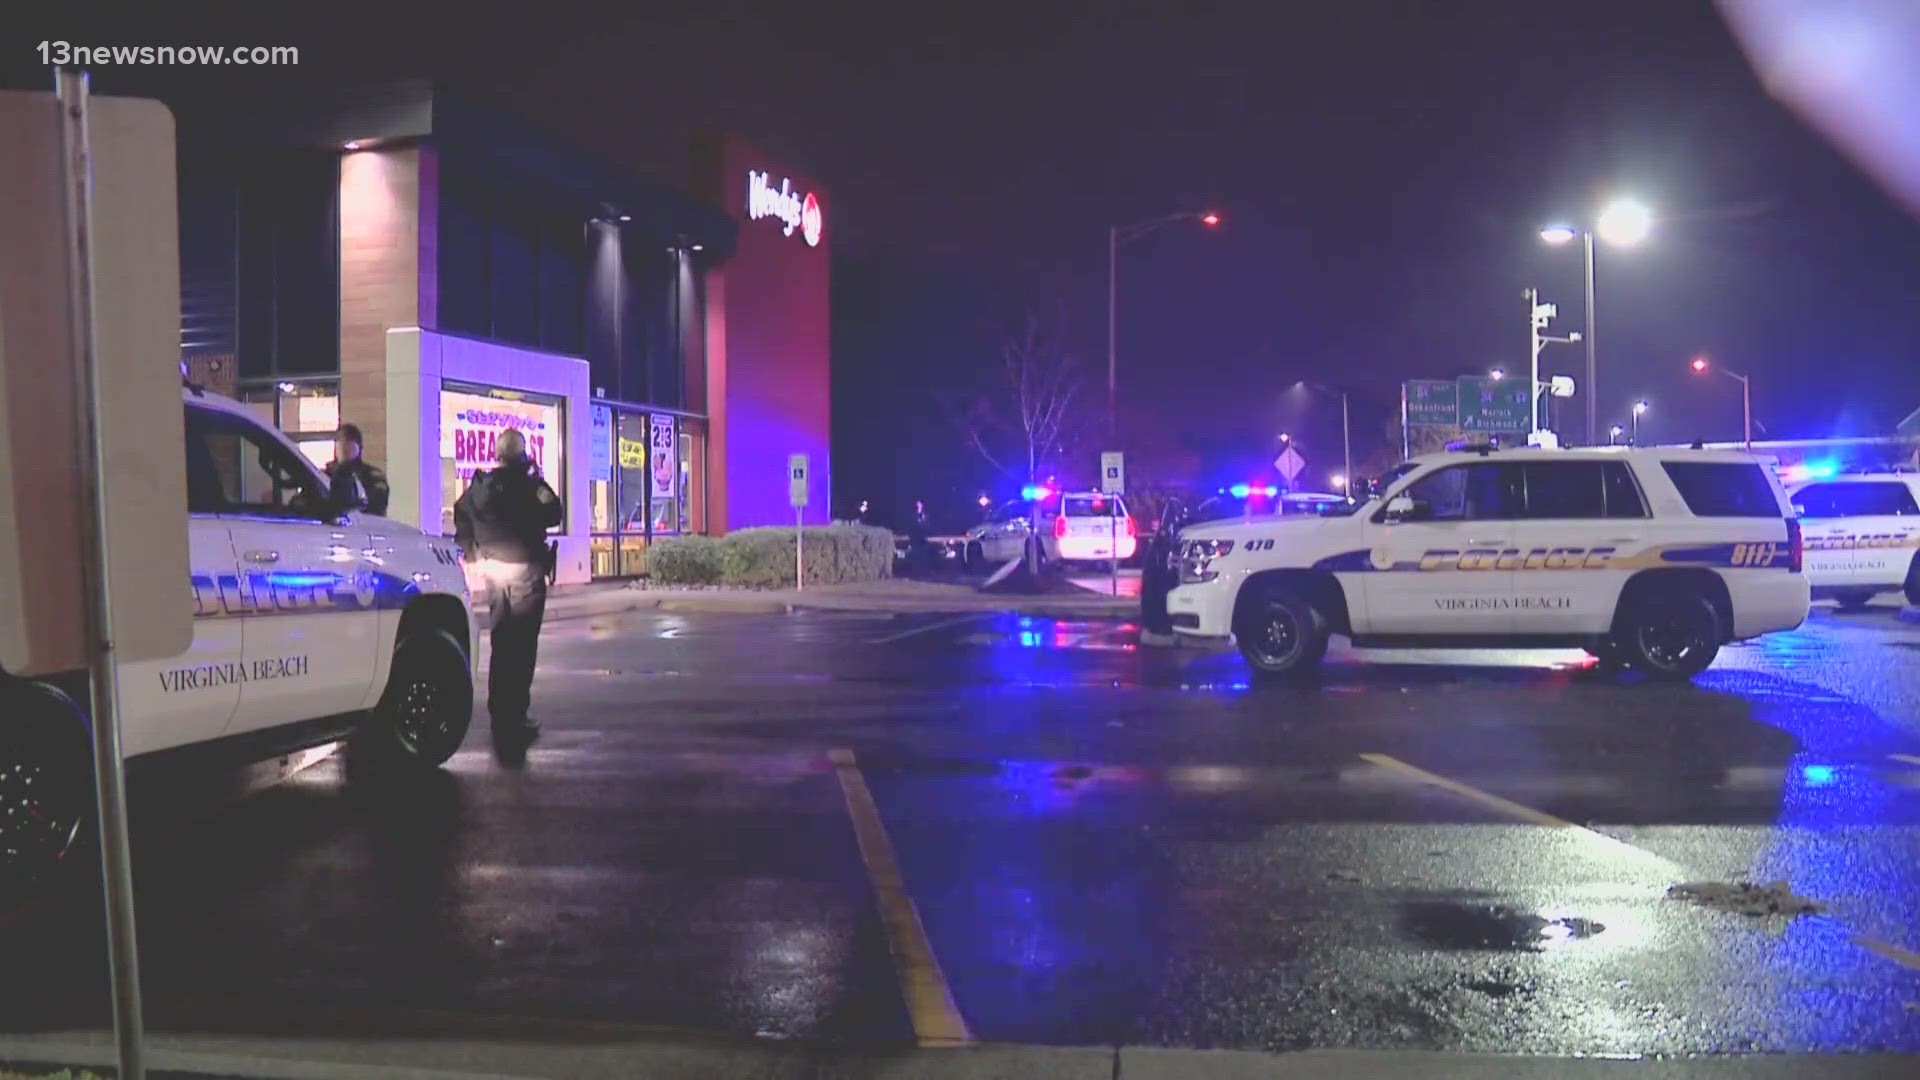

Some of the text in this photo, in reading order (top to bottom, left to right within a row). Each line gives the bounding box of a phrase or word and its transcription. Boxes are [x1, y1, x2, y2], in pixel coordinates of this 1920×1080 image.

[455, 429, 545, 466] BREAST
[1417, 547, 1617, 571] POLICE
[1434, 597, 1571, 610] VIRGINIA BEACH
[159, 655, 308, 692] VIRGINIA BEACH
